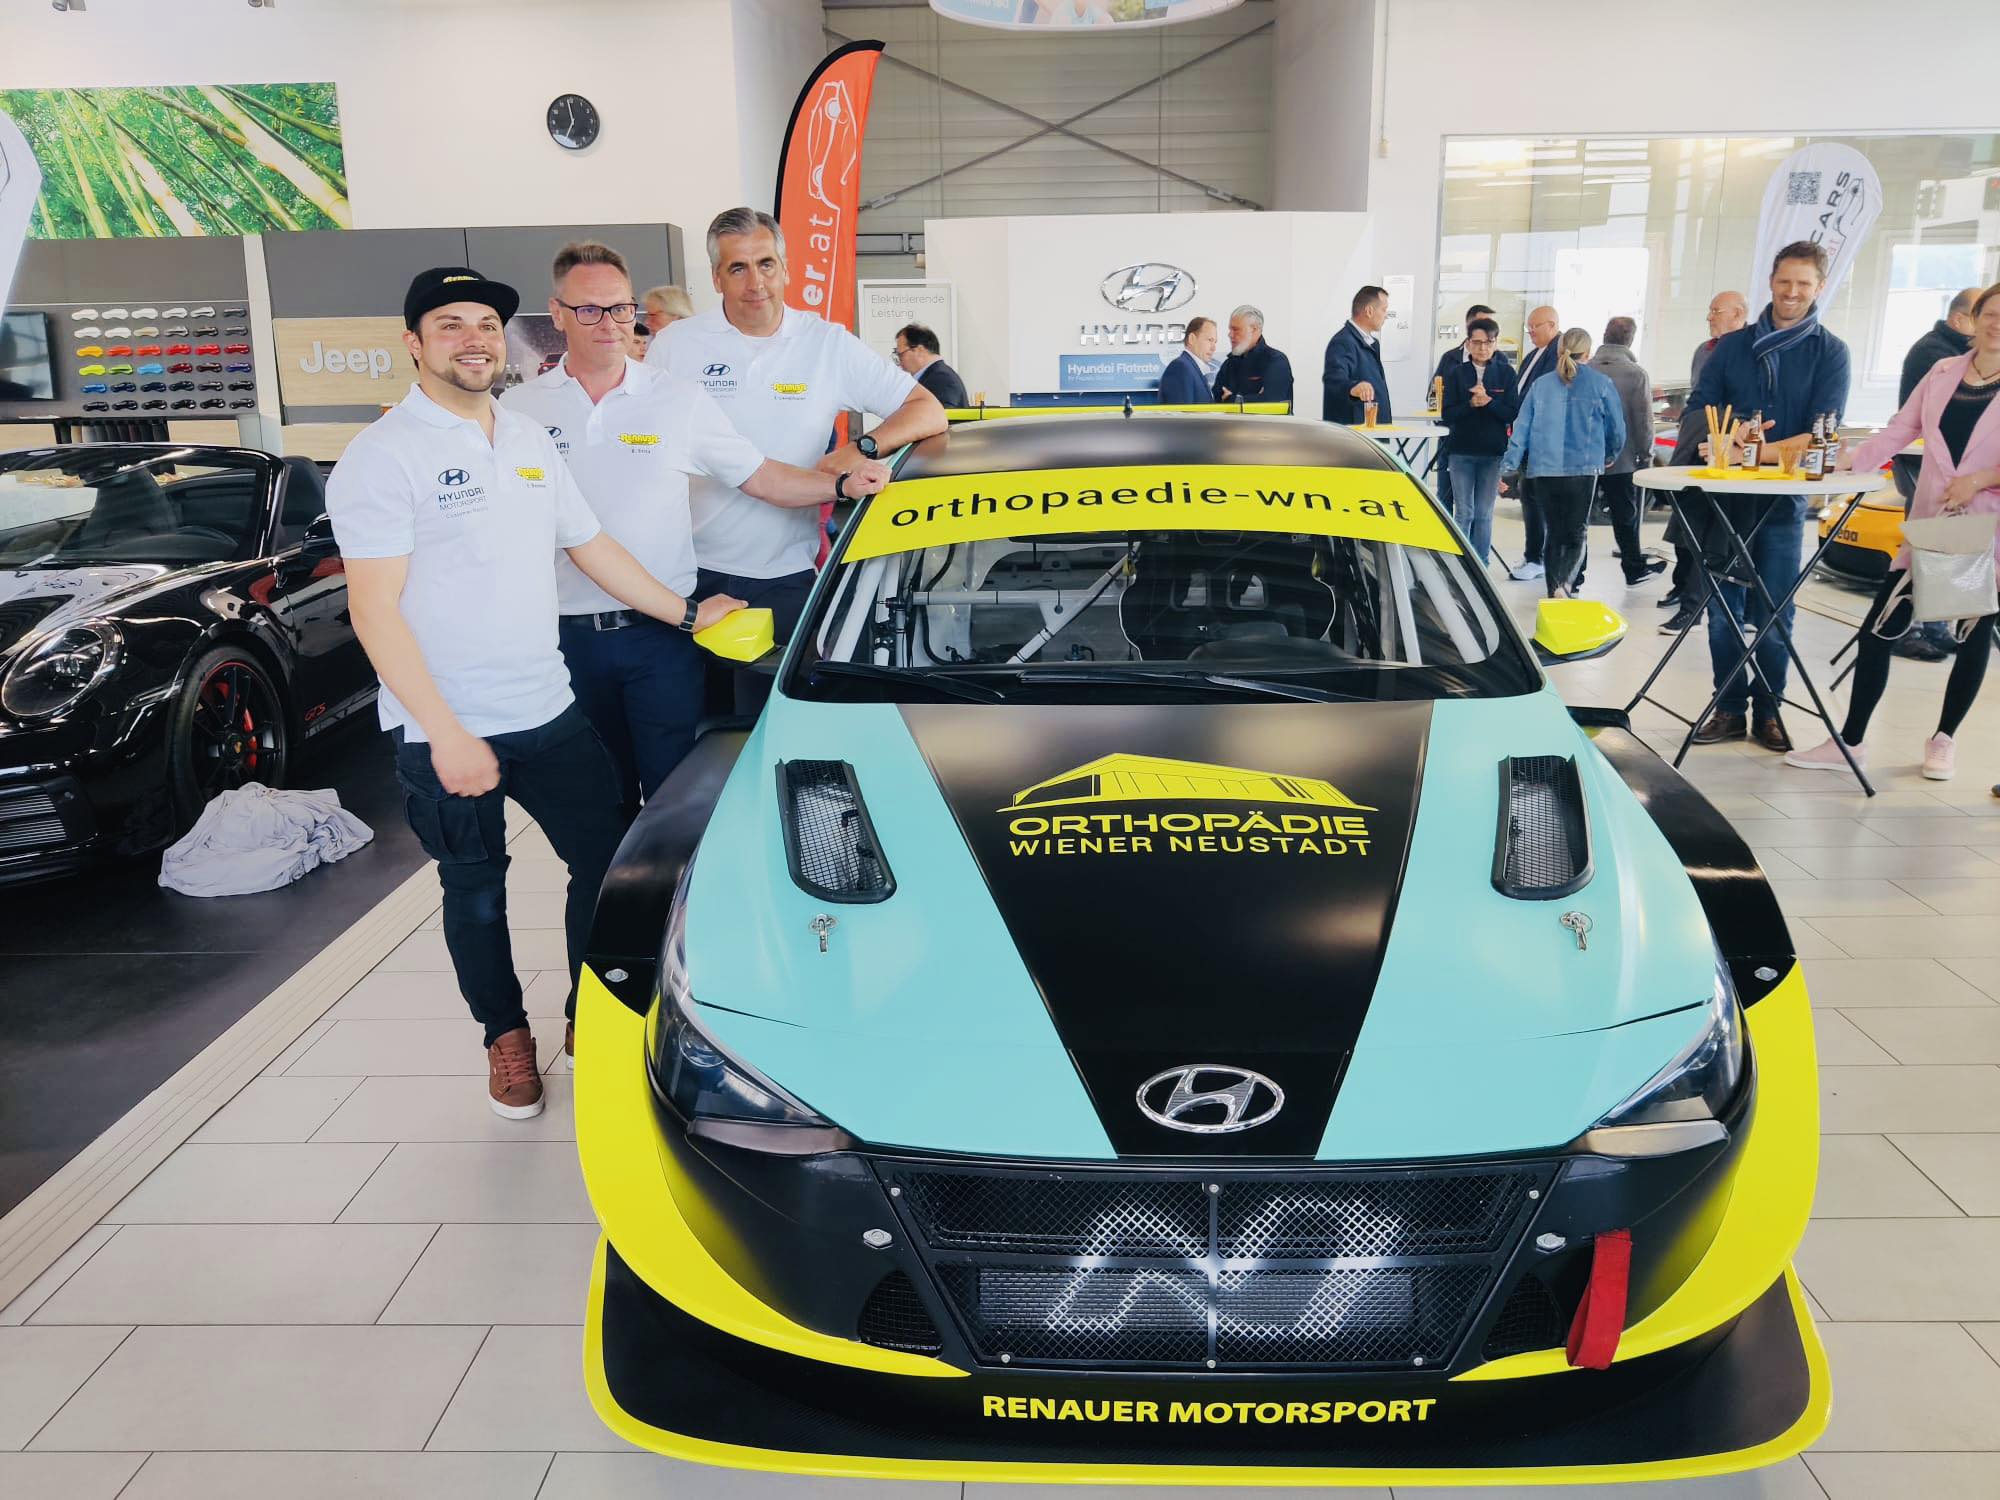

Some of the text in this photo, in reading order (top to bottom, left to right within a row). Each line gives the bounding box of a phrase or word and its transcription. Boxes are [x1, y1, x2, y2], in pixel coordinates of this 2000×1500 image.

[802, 213, 833, 306] er.at
[871, 293, 945, 305] Elektrisierende
[871, 309, 914, 320] Leistung
[1080, 323, 1186, 346] HYUND
[299, 340, 393, 380] Jeep
[1067, 361, 1161, 377] Hyundai Flatrate
[438, 487, 486, 503] HYUNDAI
[439, 496, 488, 511] MOTORSPORT
[891, 481, 1411, 528] orthopaedie-wn.at
[1009, 810, 1370, 836] ORTHOPÄDIE
[1010, 836, 1371, 857] WIENER NEUSTADT
[983, 1395, 1437, 1425] RENAUER MOTORSPORT
